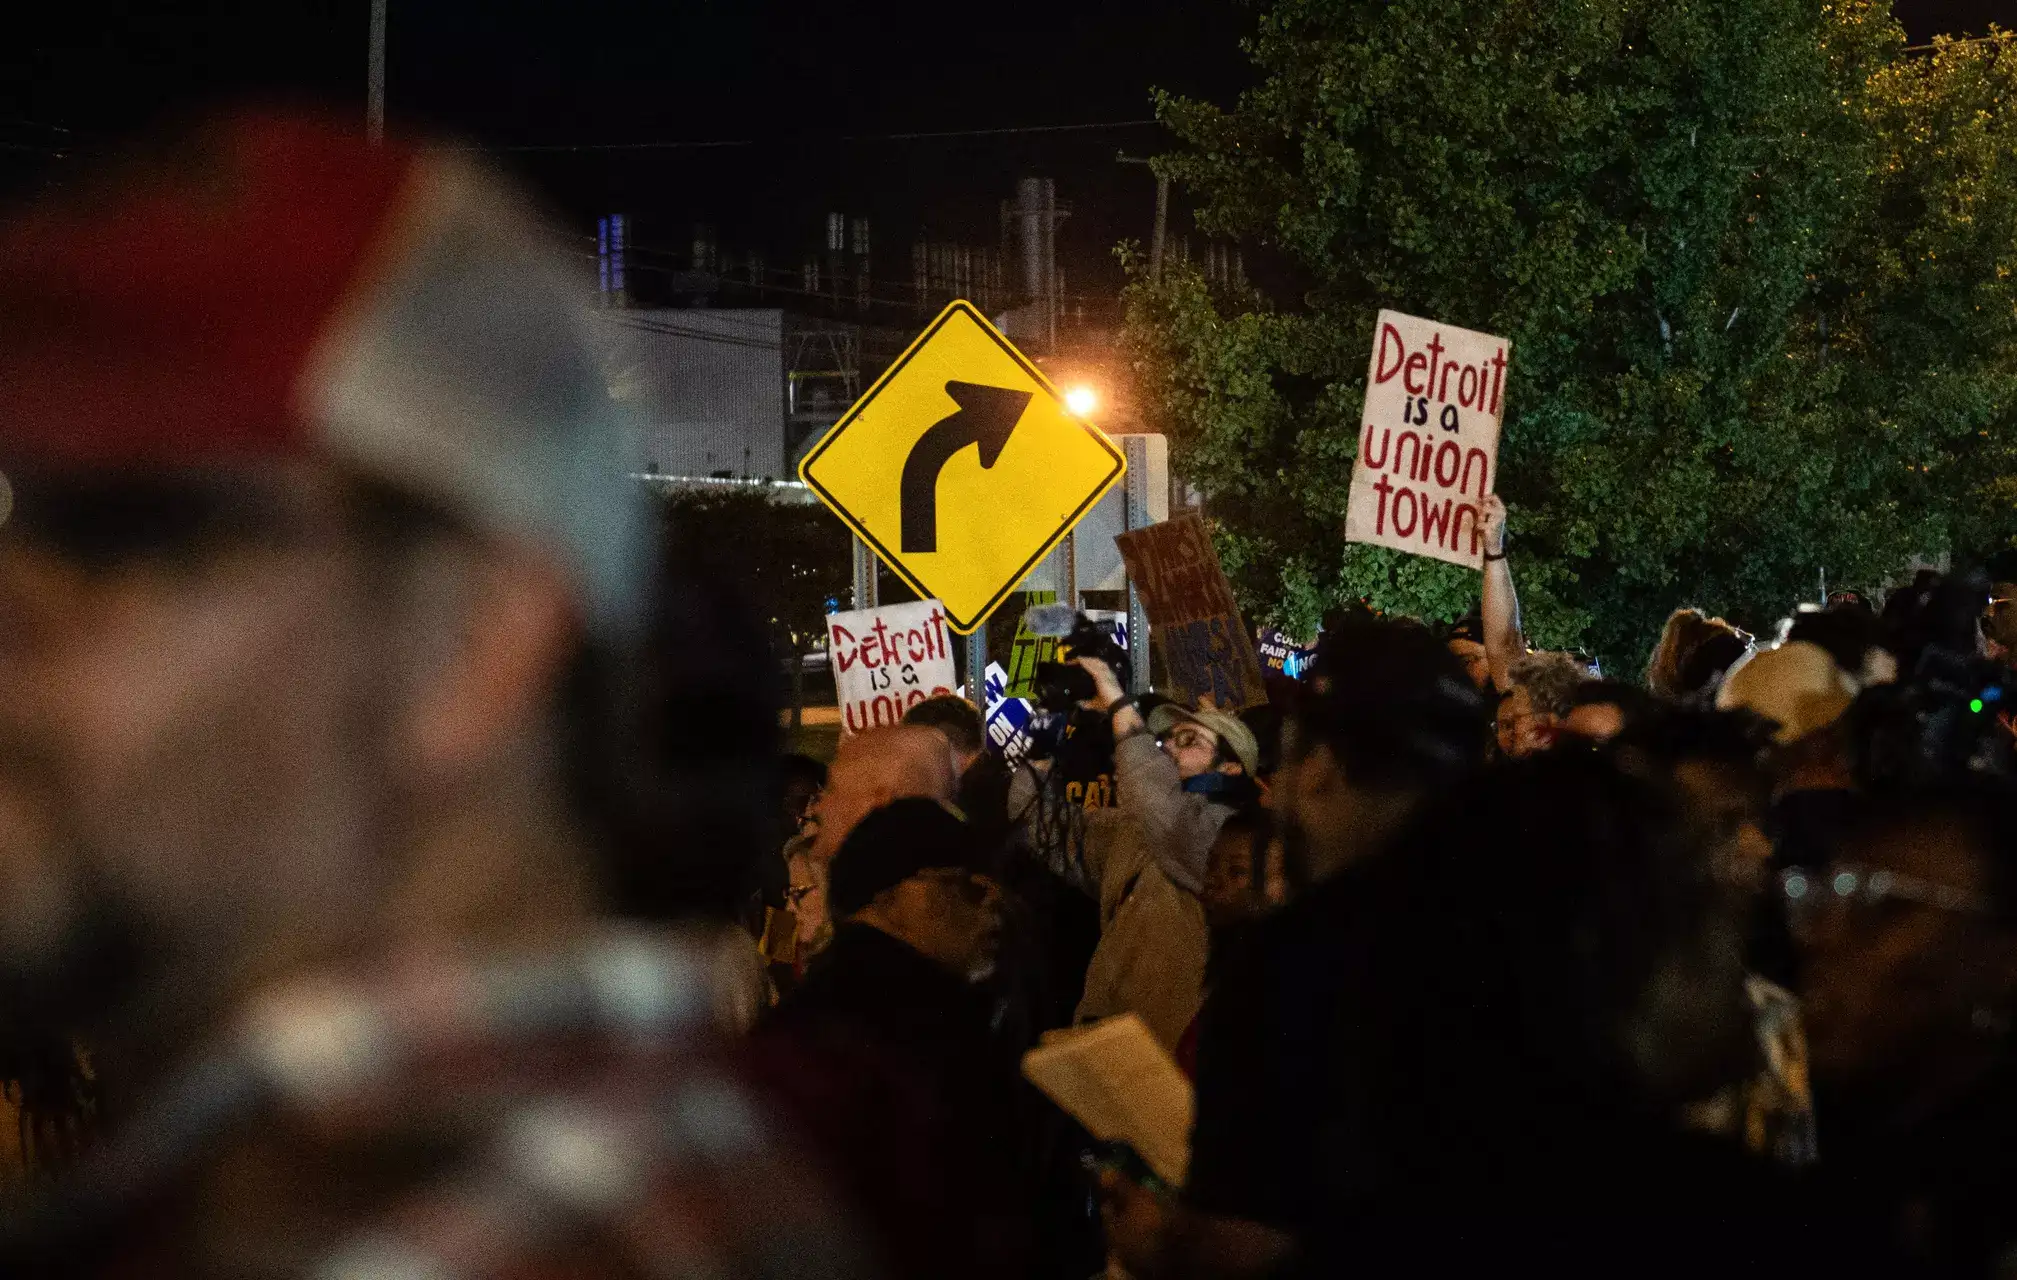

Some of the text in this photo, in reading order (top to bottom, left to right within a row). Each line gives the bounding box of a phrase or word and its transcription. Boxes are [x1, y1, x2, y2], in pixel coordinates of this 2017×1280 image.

[1375, 322, 1507, 415] Detroit
[1403, 395, 1460, 434] is a
[1363, 424, 1488, 499] union
[1372, 473, 1478, 556] town
[832, 608, 945, 673] Detroit
[1260, 643, 1287, 659] FAIR
[870, 663, 920, 691] is a
[988, 711, 1015, 747] ON
